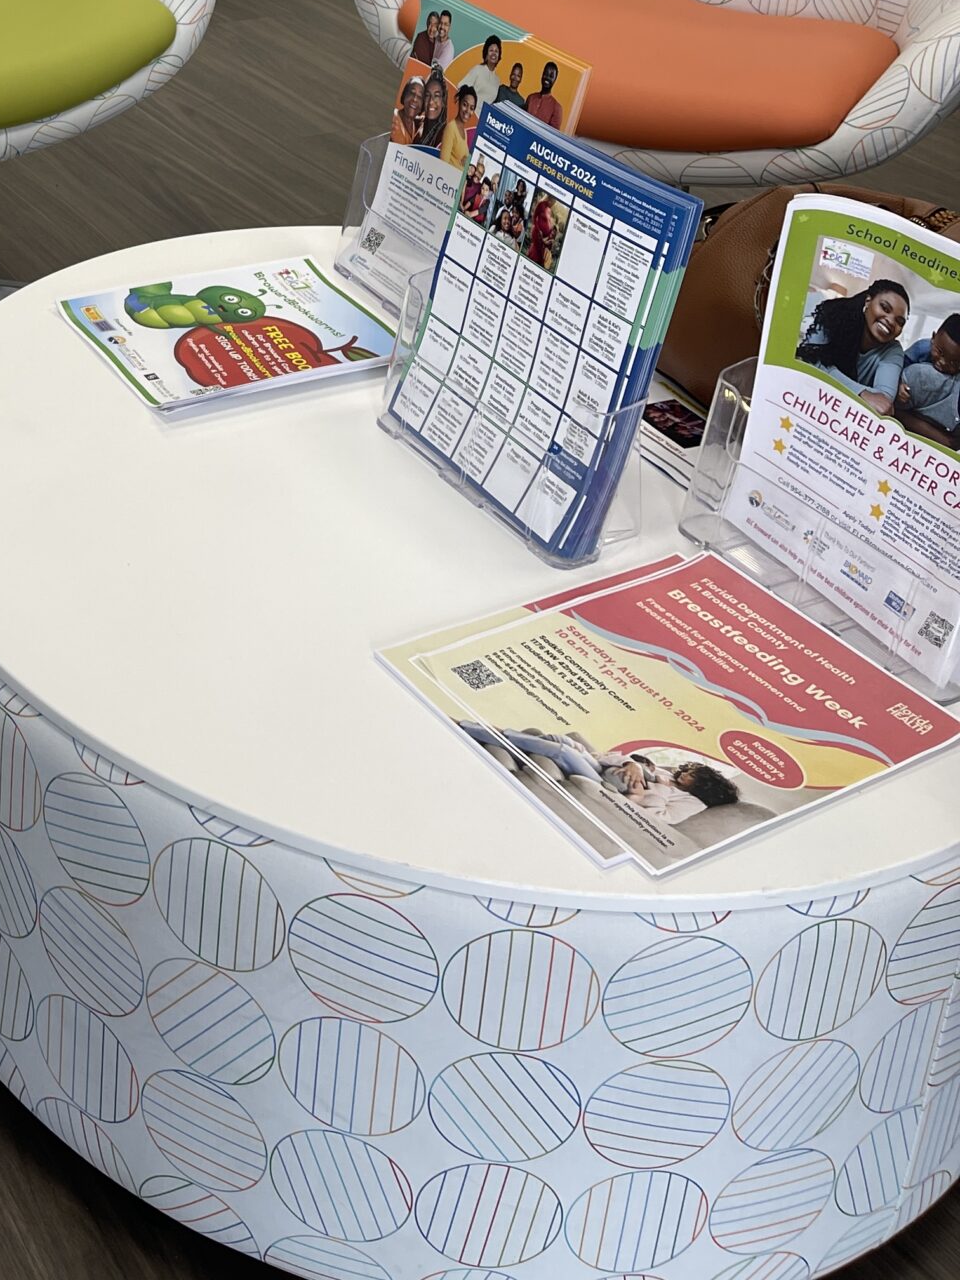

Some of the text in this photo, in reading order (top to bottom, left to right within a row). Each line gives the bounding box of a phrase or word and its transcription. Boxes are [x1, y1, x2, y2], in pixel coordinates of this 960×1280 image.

[487, 112, 506, 134] heart
[394, 151, 433, 184] Finally, a
[526, 154, 594, 199] FREE FOR EVERYONE
[529, 141, 597, 187] AUGUST 2024
[846, 224, 898, 250] School
[901, 244, 960, 282] Readine
[215, 335, 231, 351] SIGN
[262, 325, 294, 351] FREE
[782, 391, 938, 496] CHILDCARE & AFTER
[818, 388, 960, 486] WE HELP PAY FOR
[636, 601, 735, 674] breastfeeding families
[690, 582, 789, 651] in Broward County
[700, 578, 856, 686] Florida Department of Health
[555, 628, 569, 639] 10
[566, 639, 589, 657] a.m.
[645, 597, 807, 713] Free event for pregnant women and
[667, 588, 868, 730] Breastfeeding Week
[539, 635, 636, 712] Sadkin Community Center
[546, 649, 559, 661] NW
[558, 661, 578, 677] 42nd
[577, 675, 595, 691] Way
[557, 671, 567, 679] FL
[566, 625, 705, 733] Saturday, August 10, 2024
[886, 706, 929, 736] HEALTH
[727, 745, 777, 783] and more!
[732, 739, 785, 780] giveaways,
[751, 740, 785, 769] Raffles,
